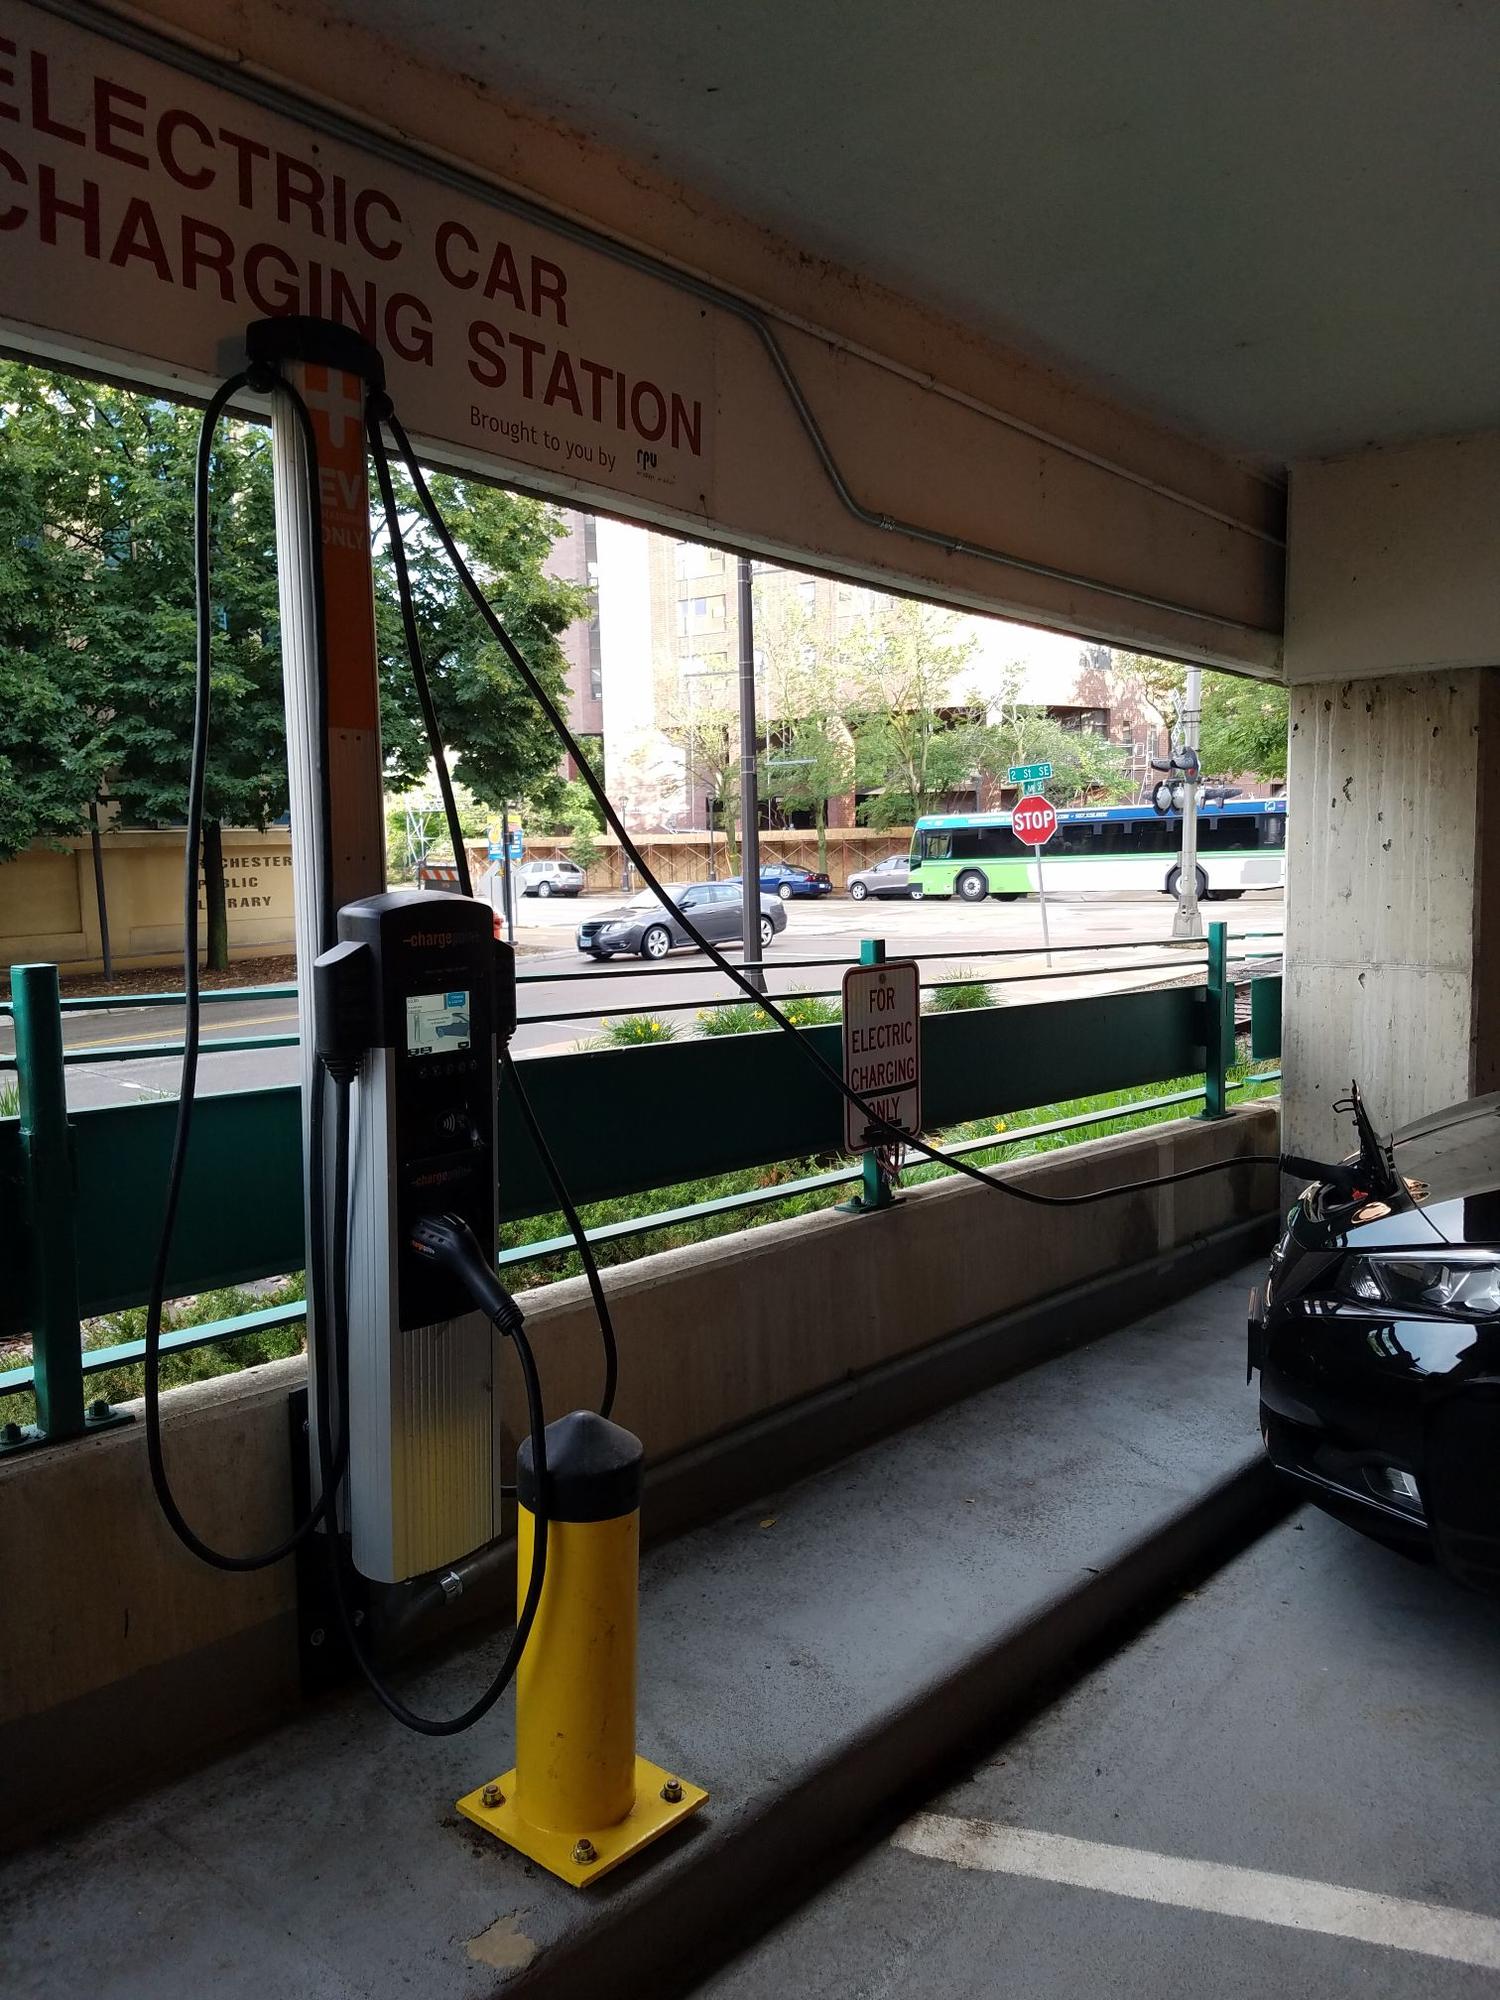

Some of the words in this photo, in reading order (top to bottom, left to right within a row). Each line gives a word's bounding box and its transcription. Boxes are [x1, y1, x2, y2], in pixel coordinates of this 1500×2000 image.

[435, 220, 569, 327] CAR
[467, 320, 702, 457] STATION
[470, 405, 537, 443] Brought
[542, 430, 560, 452] to
[566, 439, 593, 463] you
[598, 445, 616, 473] by
[636, 448, 658, 470] rpu
[319, 467, 361, 510] EV
[1010, 770, 1017, 780] 2
[1023, 768, 1032, 779] St
[1038, 765, 1050, 776] SE
[1014, 810, 1053, 831] STOP
[199, 856, 293, 869] CHESTER
[198, 877, 258, 889] PBLIC
[198, 896, 272, 910] LRARY
[869, 986, 895, 1013] FOR
[851, 1020, 913, 1054] ELECTRIC
[851, 1056, 915, 1092] CHARGING
